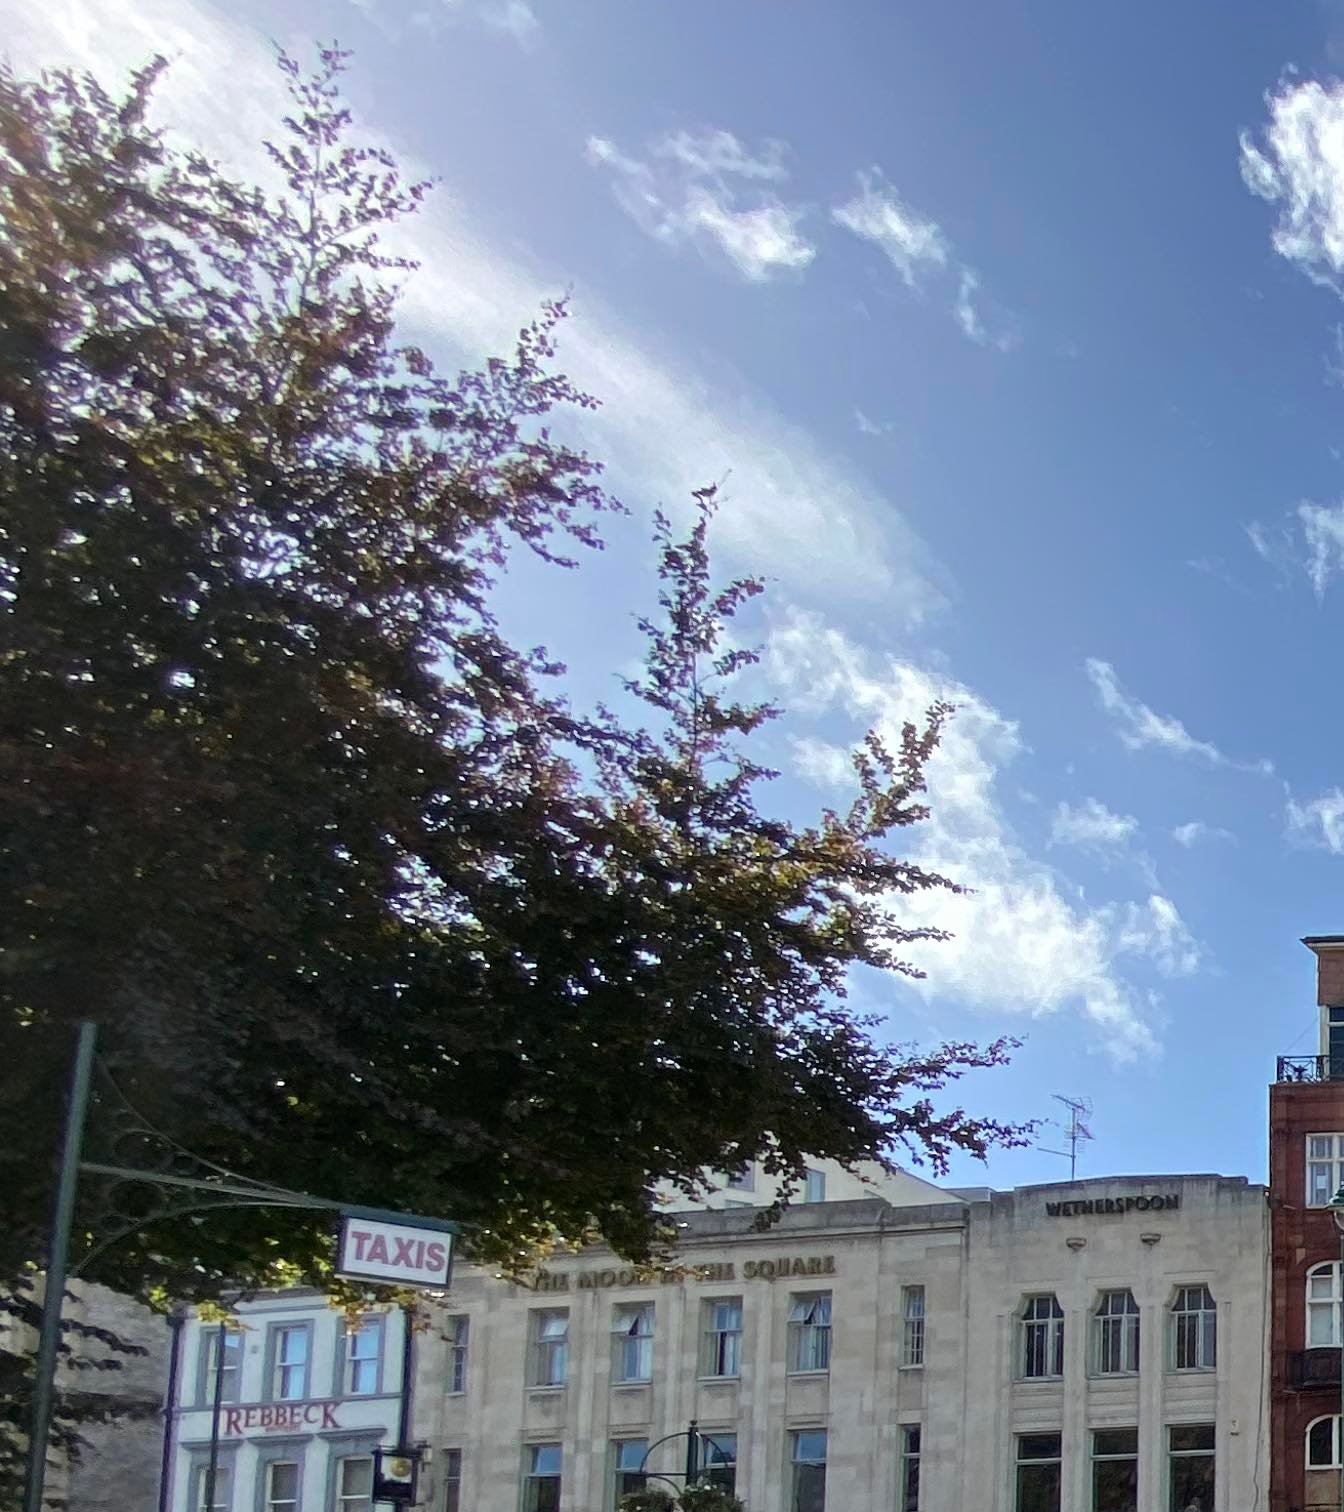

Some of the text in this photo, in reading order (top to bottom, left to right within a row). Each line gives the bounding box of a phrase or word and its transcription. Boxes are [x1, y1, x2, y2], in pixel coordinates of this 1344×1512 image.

[1046, 1194, 1181, 1217] WETHERSPOON
[351, 1231, 446, 1272] TAXIS
[743, 1255, 836, 1283] SQUARE
[225, 1401, 343, 1435] REBBECK
